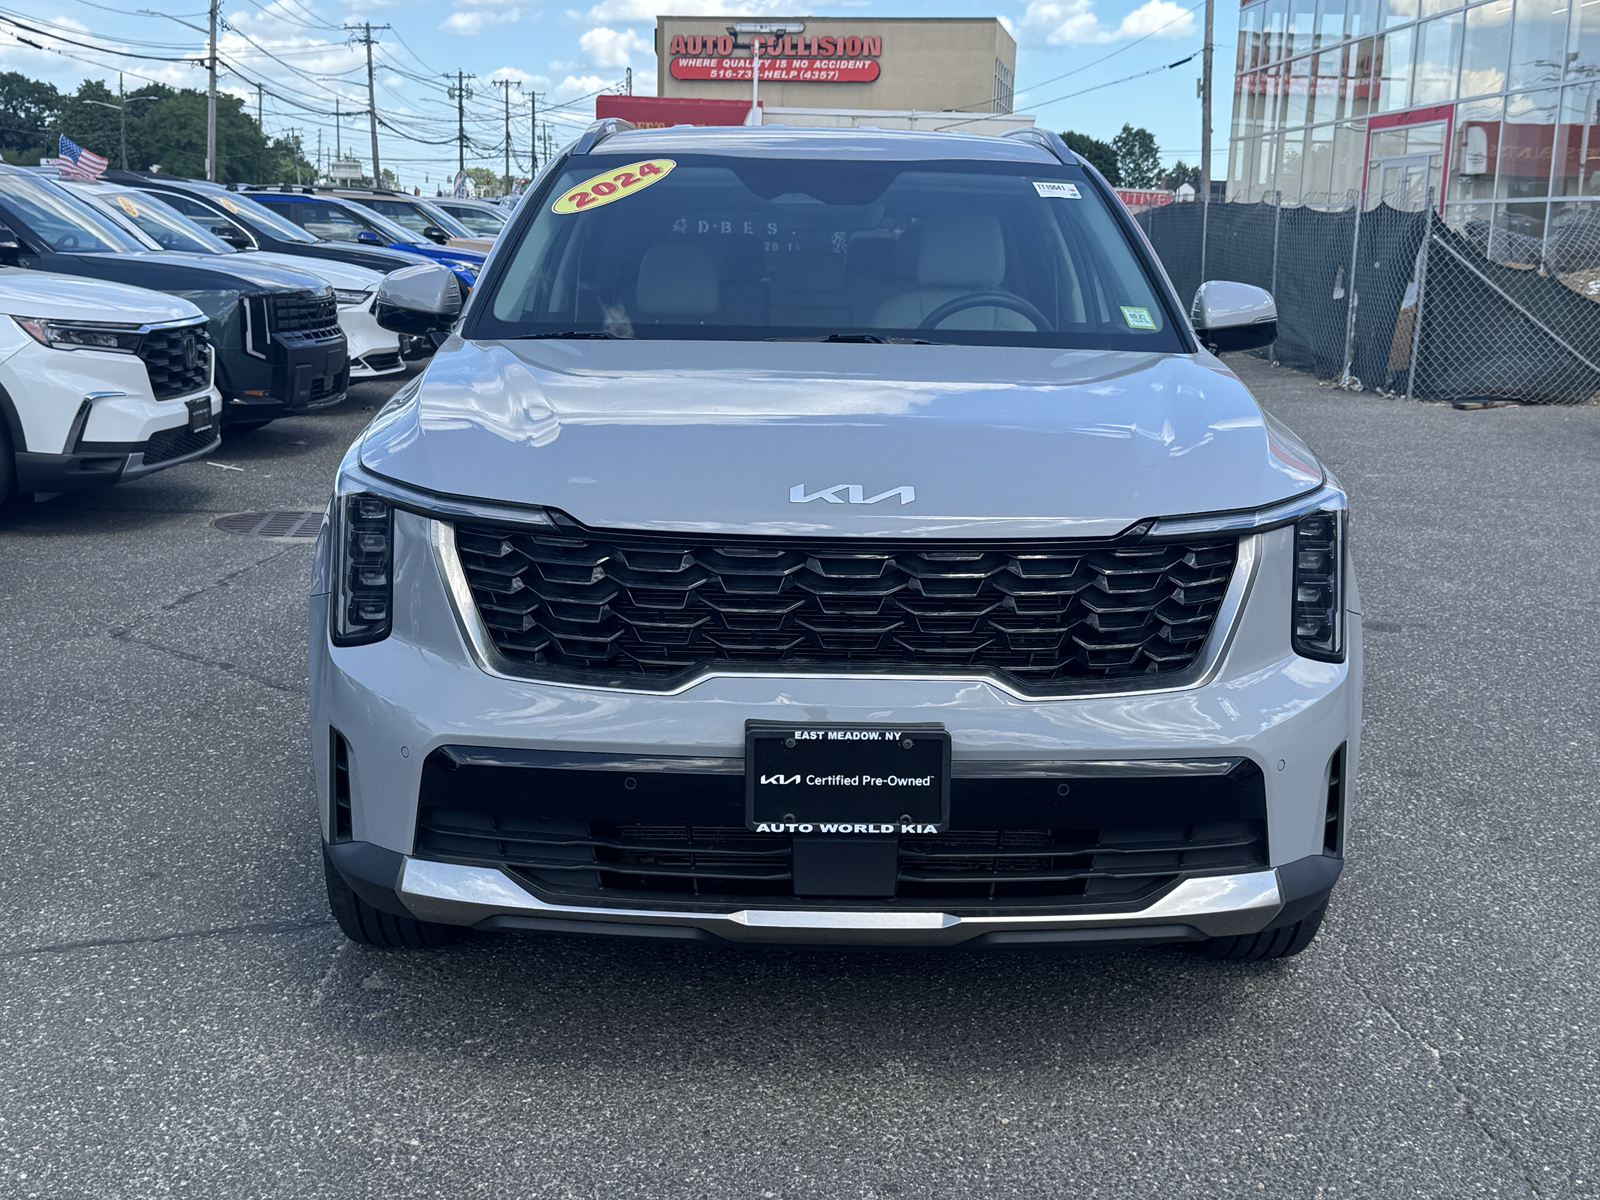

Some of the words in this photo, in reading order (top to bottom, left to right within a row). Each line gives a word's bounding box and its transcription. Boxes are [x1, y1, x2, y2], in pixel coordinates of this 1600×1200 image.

[670, 35, 733, 56] AUTO
[750, 35, 882, 57] COLLISION
[679, 59, 718, 68] WHERE
[722, 59, 771, 68] QUALITY
[776, 59, 788, 68] IS
[792, 60, 809, 68] NO
[813, 60, 872, 70] ACCIDENT
[799, 70, 839, 80] (4357)
[568, 163, 664, 208] 2024
[789, 483, 916, 506] KIA
[794, 731, 824, 740] EAST
[885, 731, 902, 741] NY
[760, 774, 801, 785] KIA
[806, 774, 859, 786] Certified
[756, 823, 813, 833] AUTO
[819, 823, 894, 834] WORLD
[901, 824, 938, 834] KIA
